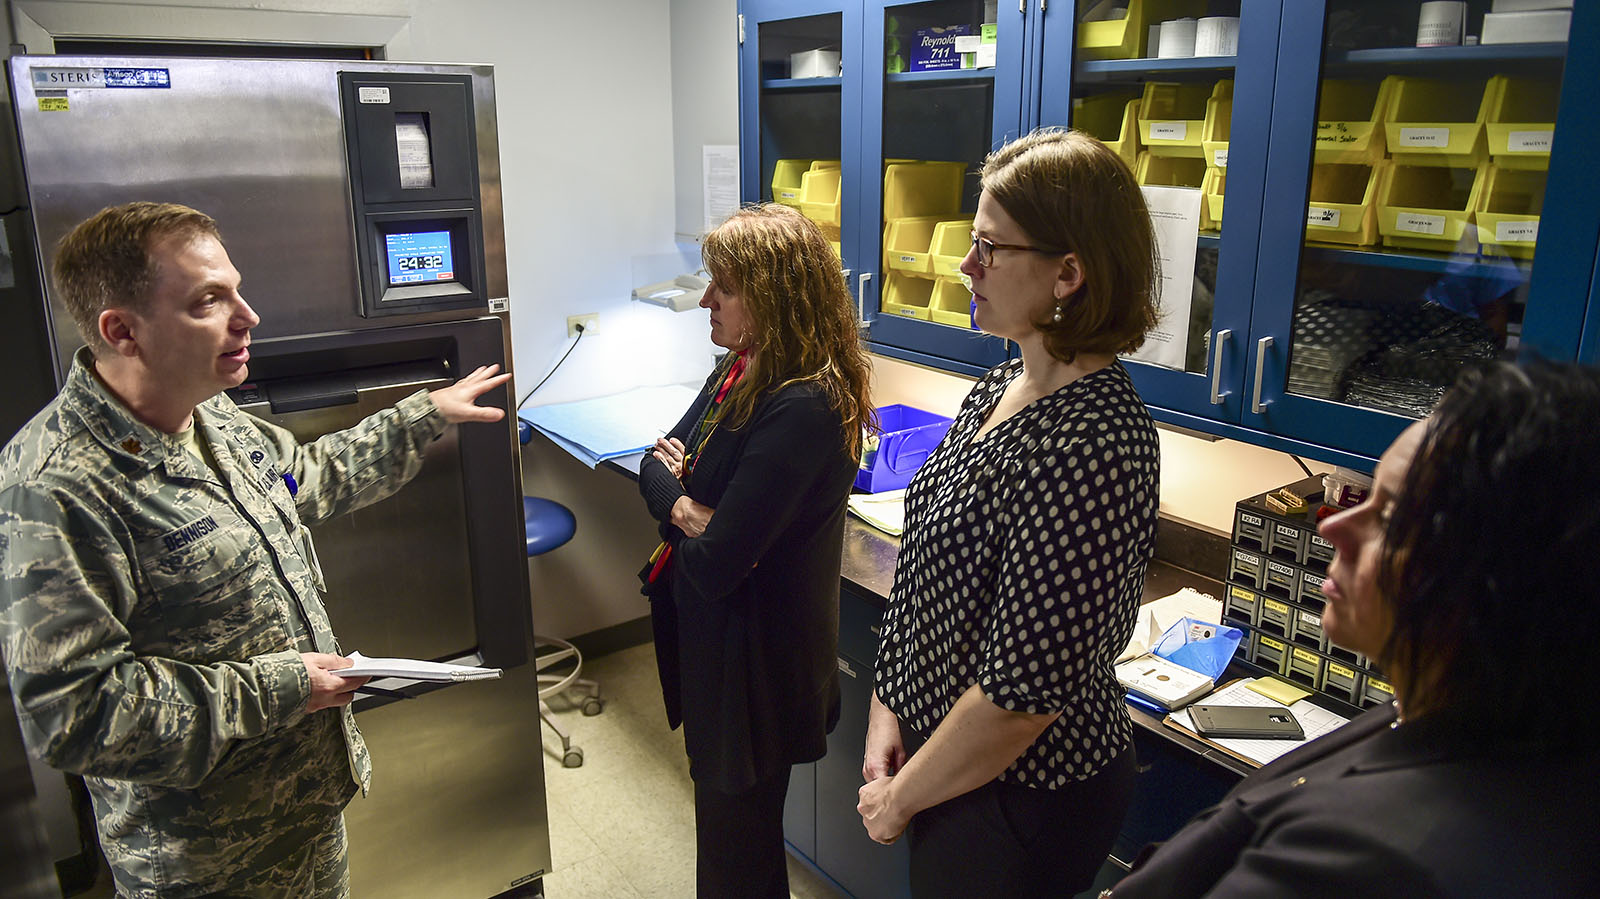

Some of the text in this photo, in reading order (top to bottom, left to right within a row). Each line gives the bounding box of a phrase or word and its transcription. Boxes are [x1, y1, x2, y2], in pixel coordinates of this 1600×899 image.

[921, 34, 956, 48] Reynold
[931, 47, 950, 59] 711
[50, 72, 97, 83] STERIS
[399, 255, 443, 270] 24:32
[1251, 517, 1260, 525] RA
[164, 515, 219, 552] DENNISON
[1287, 529, 1297, 537] RA
